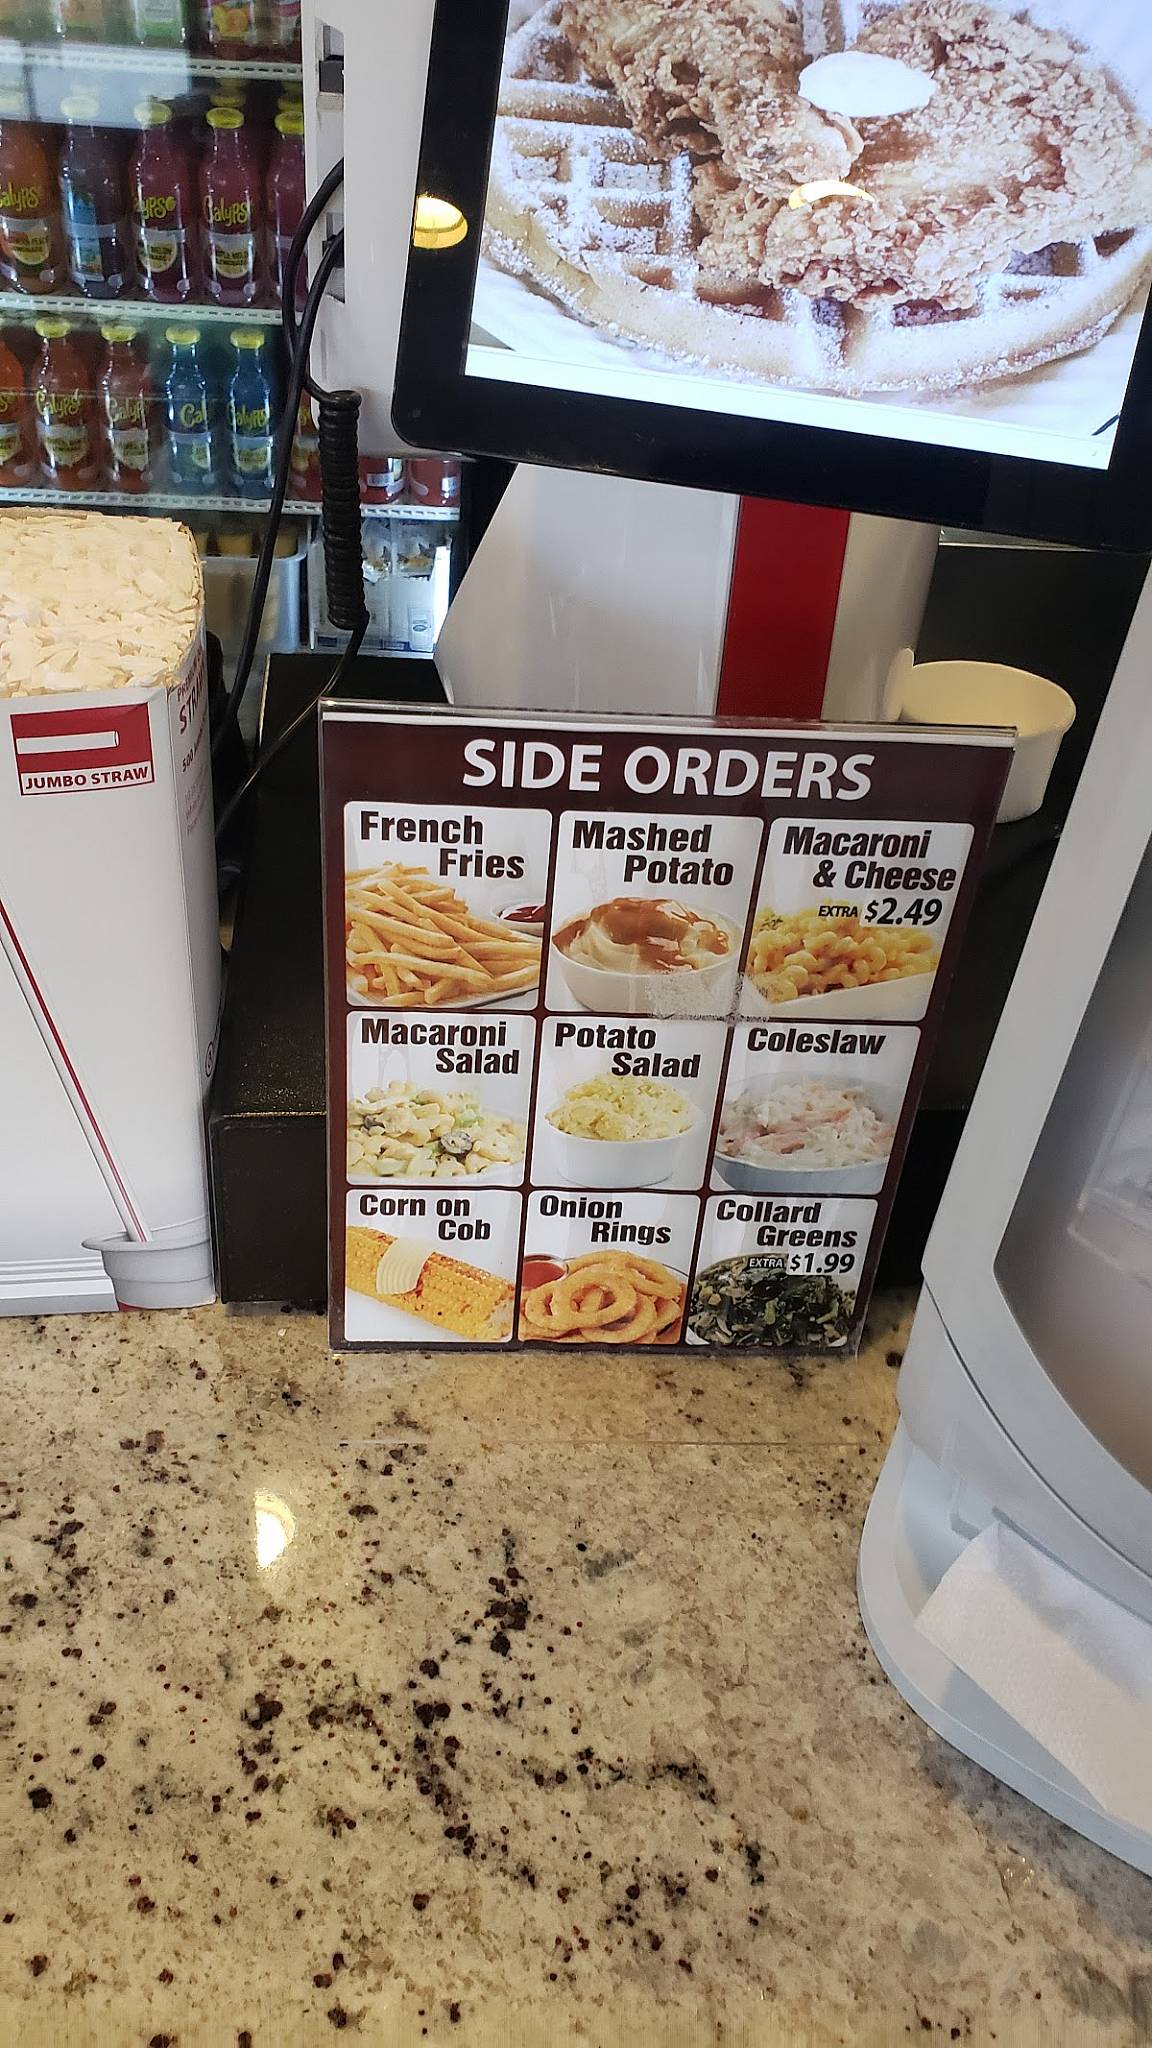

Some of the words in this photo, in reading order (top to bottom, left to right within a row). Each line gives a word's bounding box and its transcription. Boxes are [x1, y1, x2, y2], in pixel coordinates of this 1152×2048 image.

[0, 181, 39, 211] alyps
[203, 194, 253, 227] Calyps
[35, 390, 80, 418] Calyps
[25, 775, 87, 789] JUMBO
[91, 766, 149, 785] STRAW
[462, 738, 603, 792] SIDE
[623, 745, 876, 801] ORDERS
[360, 810, 484, 845] French
[572, 820, 713, 852] Mashed
[782, 826, 932, 858] Macaroni
[438, 848, 525, 879] Fries
[623, 854, 734, 886] Potato
[812, 859, 837, 888] &
[844, 860, 957, 890] Cheese
[818, 904, 858, 918] EXTRA
[864, 897, 943, 926] $2.49
[361, 1018, 506, 1047] Macaroni
[554, 1022, 656, 1049] Potato
[747, 1027, 887, 1055] Coleslaw
[435, 1047, 519, 1075] Salad
[611, 1052, 701, 1078] Salad
[359, 1193, 426, 1217] Corn
[436, 1196, 470, 1217] on
[539, 1194, 622, 1219] Onion
[716, 1199, 822, 1224] Collard
[438, 1219, 490, 1241] Cob
[590, 1221, 672, 1245] Rings
[756, 1225, 858, 1248] Greens
[749, 1257, 783, 1268] EXTRA
[789, 1252, 855, 1274] $1.99
